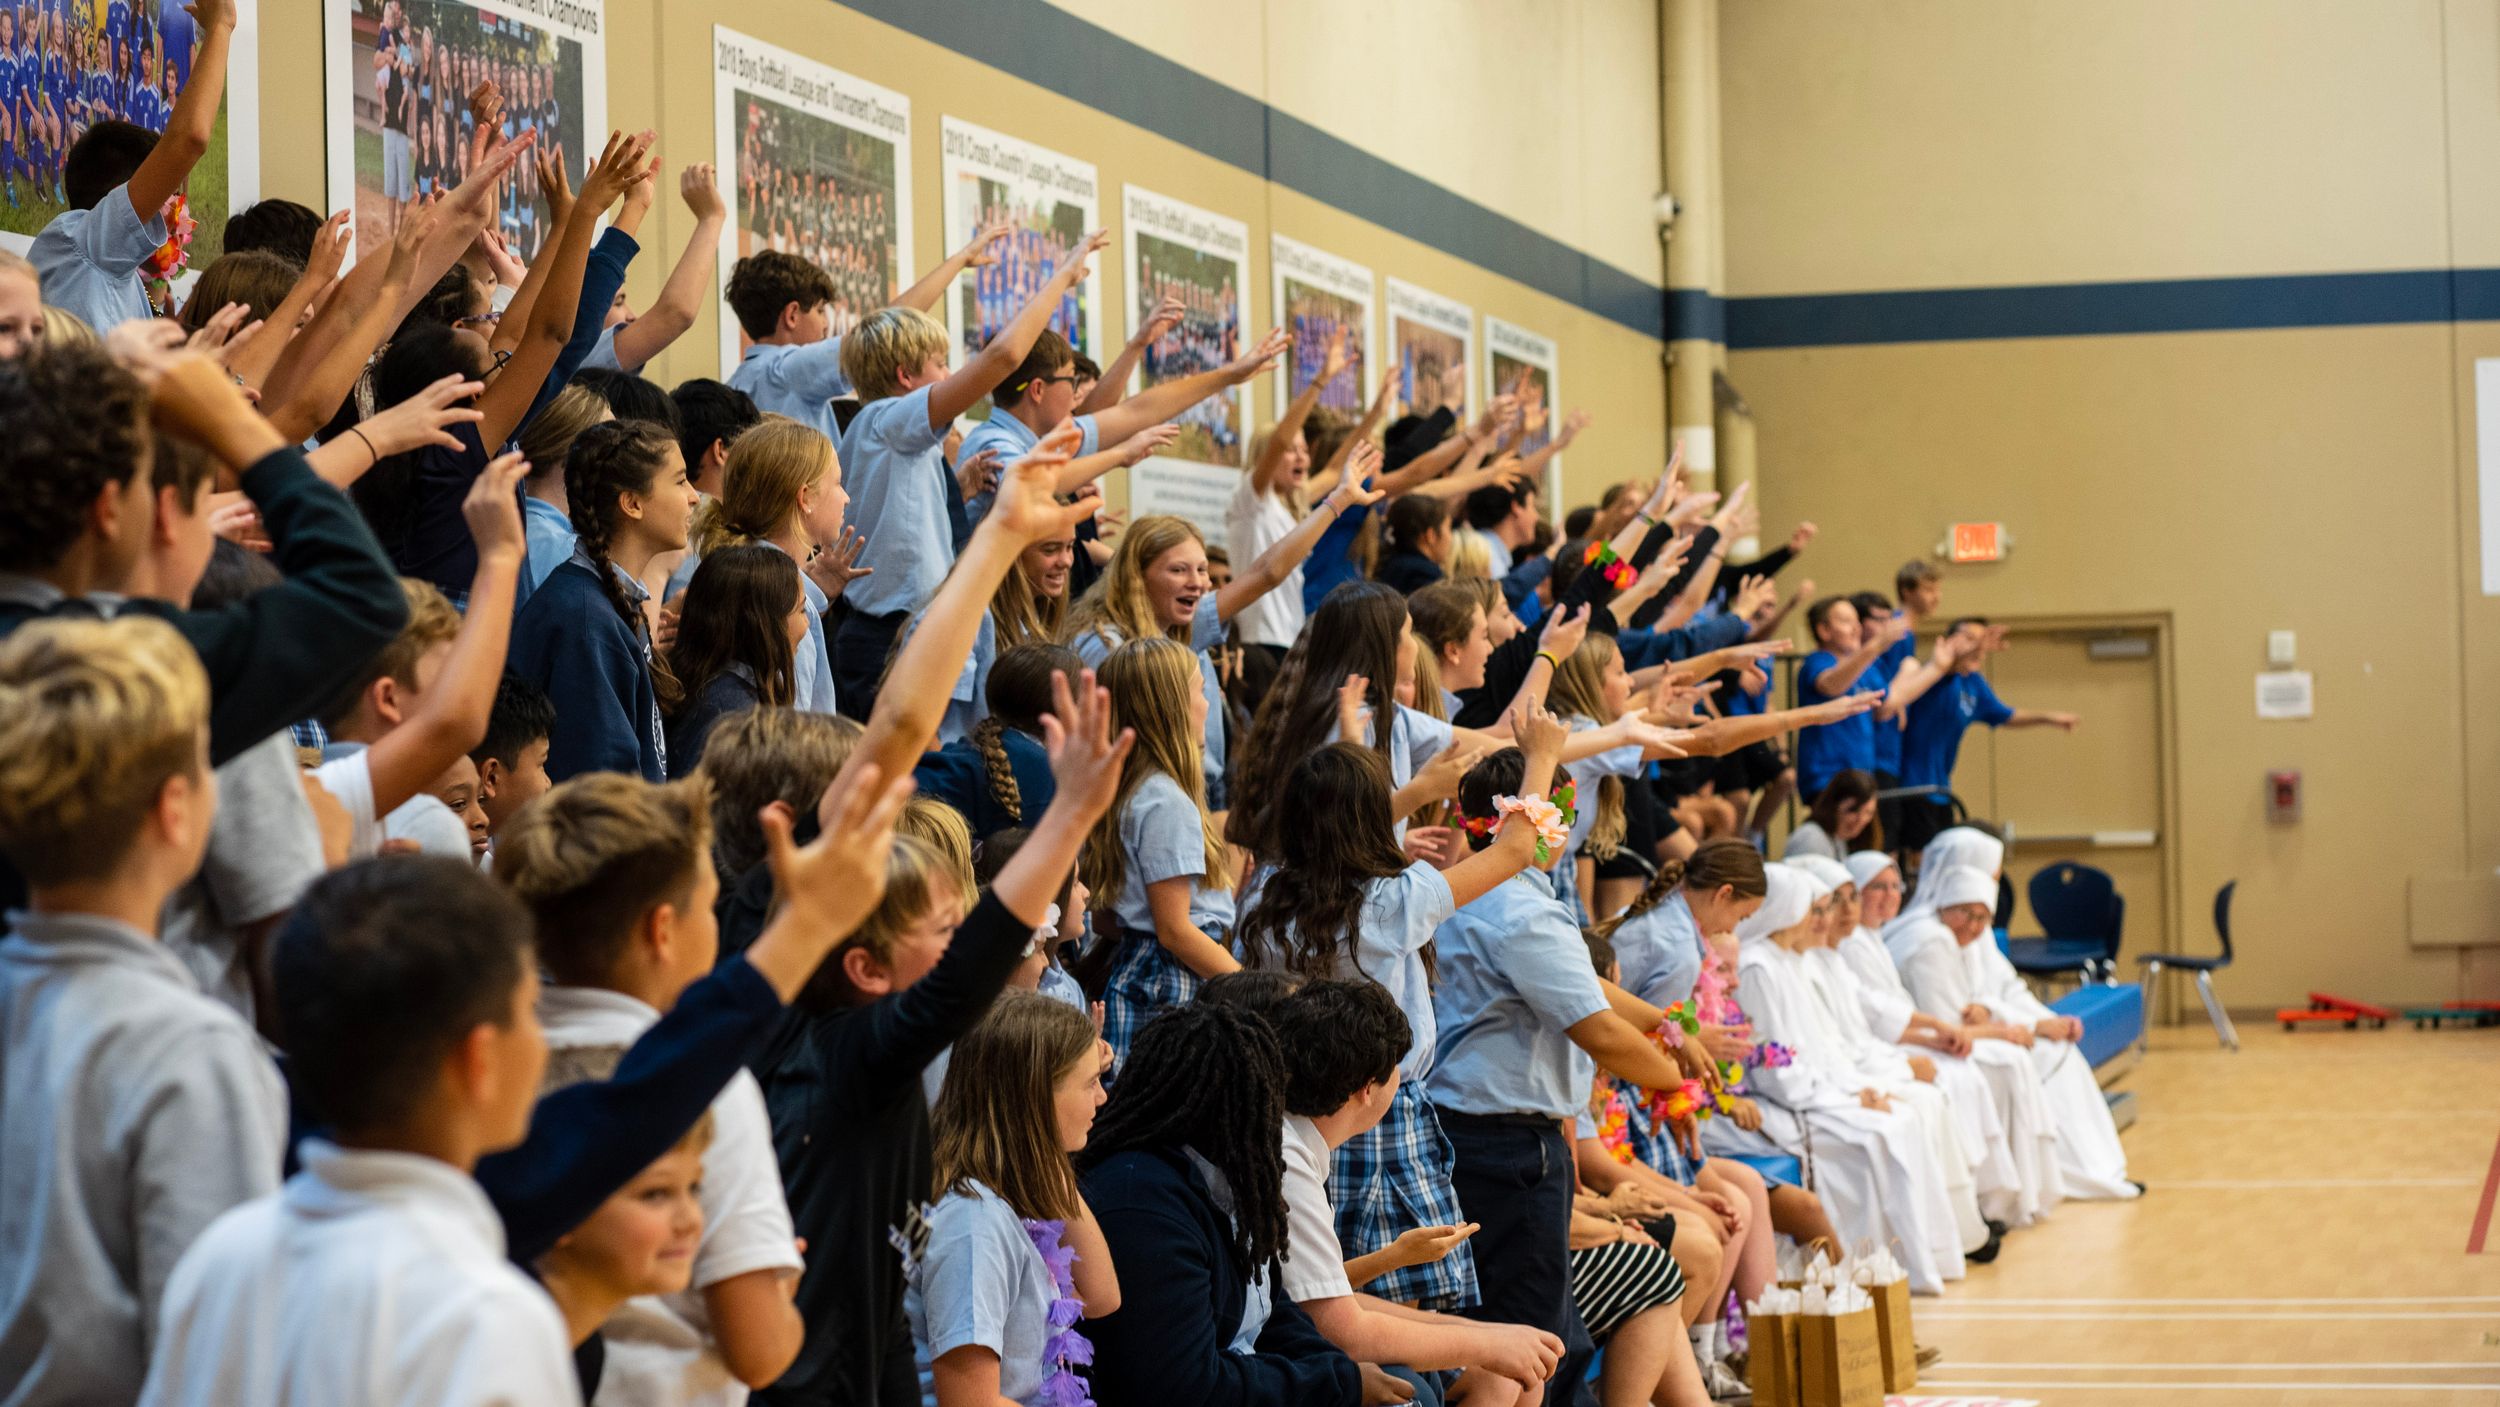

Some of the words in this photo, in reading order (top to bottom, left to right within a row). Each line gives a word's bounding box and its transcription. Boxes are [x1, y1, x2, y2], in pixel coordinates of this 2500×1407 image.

[738, 48, 758, 88] Boys
[759, 55, 787, 92] Softball
[788, 66, 814, 107] League
